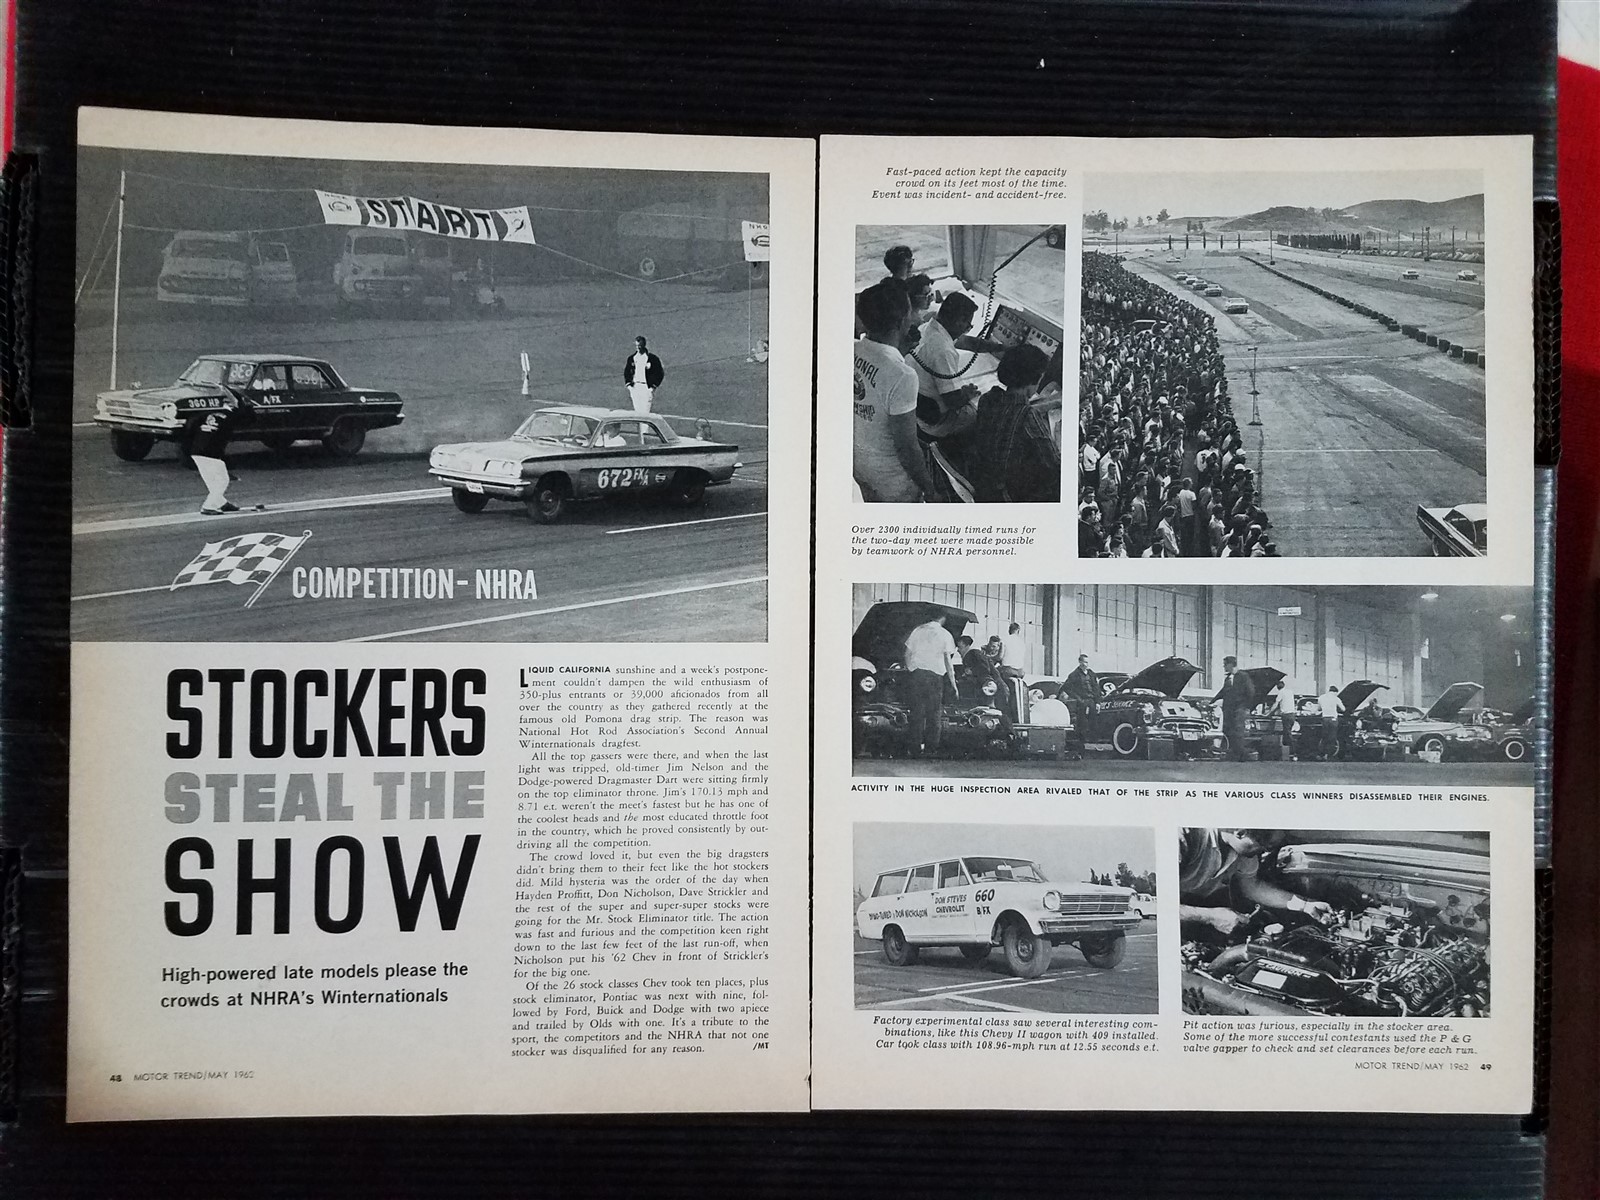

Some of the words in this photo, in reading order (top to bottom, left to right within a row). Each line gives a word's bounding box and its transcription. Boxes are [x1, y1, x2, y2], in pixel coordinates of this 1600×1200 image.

[886, 168, 942, 178] Fast-paced
[945, 168, 976, 176] action
[980, 168, 1002, 177] kept
[1005, 168, 1021, 176] the
[1024, 168, 1067, 177] capacity
[872, 190, 901, 198] Event
[975, 190, 994, 198] and
[996, 190, 1066, 200] accident-free.
[367, 199, 492, 239] START
[597, 469, 632, 489] 672
[852, 525, 875, 533] Over
[878, 526, 899, 534] 2300
[903, 526, 961, 535] individually
[965, 526, 993, 534] timed
[1021, 526, 1036, 534] for
[852, 547, 863, 556] by
[867, 547, 914, 555] teamwork
[917, 547, 928, 556] of
[930, 547, 962, 555] NHRA
[966, 548, 1016, 556] personnel.
[476, 569, 538, 600] NHRA
[616, 666, 655, 674] sunshine
[660, 665, 676, 674] and
[691, 665, 719, 673] week's
[166, 668, 486, 759] STOCKERS
[519, 727, 560, 736] National
[571, 727, 588, 735] Hot
[598, 726, 617, 735] Rod
[627, 726, 684, 735] Association's
[694, 726, 725, 734] Second
[735, 726, 768, 734] Annual
[518, 776, 592, 788] Dodge-powered
[598, 776, 652, 786] Dragmaster
[656, 775, 677, 784] Dart
[708, 774, 737, 785] sitting
[742, 774, 768, 784] firmly
[961, 786, 1010, 794] INSPECTION
[164, 772, 354, 824] STEAL
[374, 771, 485, 820] THE
[164, 834, 481, 936] SHOW
[516, 890, 552, 901] Hayden
[598, 889, 618, 898] Don
[624, 888, 674, 898] Nicholson,
[679, 887, 703, 896] Dave
[708, 887, 747, 896] Strickler
[752, 886, 768, 895] and
[975, 889, 995, 903] 660
[936, 905, 965, 913] CHEVROLET
[163, 966, 276, 984] High-powered
[284, 966, 313, 979] late
[321, 964, 378, 978] models
[386, 963, 436, 980] please
[443, 962, 468, 976] the
[161, 993, 219, 1008] crowds
[227, 993, 243, 1006] at
[251, 991, 314, 1005] NHRA's
[322, 988, 448, 1004] Winternationals
[513, 994, 536, 1004] stock
[544, 994, 596, 1003] eliminator,
[603, 992, 637, 1002] Pontiac
[696, 990, 716, 1000] with
[723, 990, 746, 1000] nine,
[873, 1016, 912, 1026] Factory
[915, 1017, 982, 1026] experimental
[985, 1018, 1009, 1026] class
[1036, 1019, 1071, 1027] several
[1074, 1019, 1129, 1030] interesting
[1183, 1021, 1198, 1029] Pit
[1202, 1021, 1234, 1031] action
[1259, 1021, 1298, 1031] furious,
[1301, 1022, 1350, 1031] especially
[1354, 1022, 1364, 1030] in
[1368, 1022, 1384, 1030] the
[1387, 1022, 1424, 1031] stocker
[876, 1039, 894, 1048] Car
[923, 1040, 947, 1048] class
[950, 1040, 972, 1048] with
[976, 1041, 1034, 1051] 108.96-mph
[1060, 1042, 1070, 1051] at
[1074, 1042, 1097, 1051] 12.55
[1102, 1043, 1140, 1051] seconds
[1184, 1044, 1210, 1052] valve
[1213, 1046, 1248, 1054] gapper
[1252, 1044, 1262, 1052] to
[1264, 1044, 1294, 1052] check
[1297, 1044, 1316, 1052] and
[1337, 1045, 1390, 1053] clearances
[1394, 1045, 1426, 1054] before
[1429, 1046, 1452, 1054] each
[109, 1075, 122, 1084] 48
[134, 1072, 169, 1081] MOTOR
